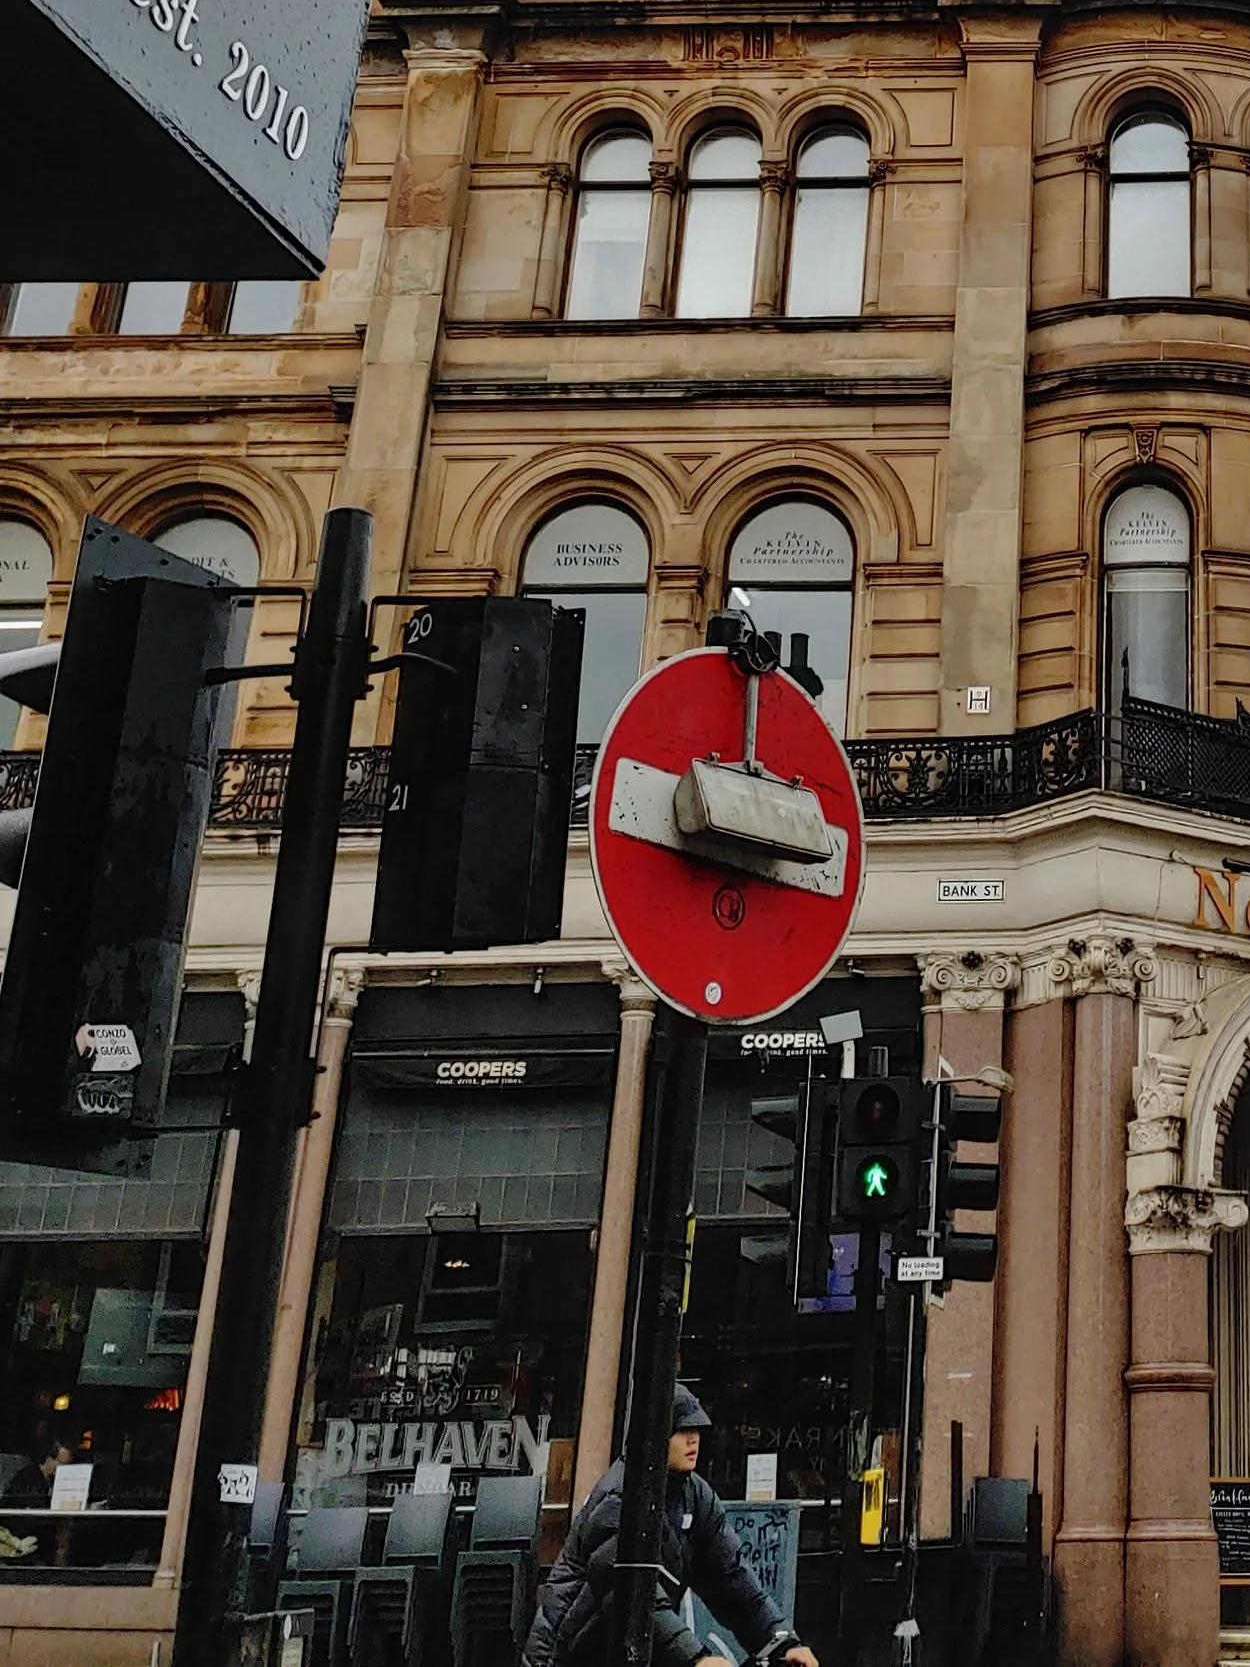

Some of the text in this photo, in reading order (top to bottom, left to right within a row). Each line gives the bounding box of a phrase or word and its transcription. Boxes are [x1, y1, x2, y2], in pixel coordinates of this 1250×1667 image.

[219, 41, 309, 161] 2010
[556, 543, 623, 555] BUSINESS
[753, 546, 834, 557] Partnership
[553, 556, 620, 567] ADVISORS
[408, 613, 433, 644] 20
[388, 784, 409, 811] 21
[942, 885, 977, 897] BANK
[96, 1029, 126, 1038] CONZO
[741, 1032, 825, 1049] COOPERS
[437, 1061, 527, 1077] COOPERS
[466, 1389, 499, 1401] 1719
[324, 1414, 551, 1477] BELHAVEN
